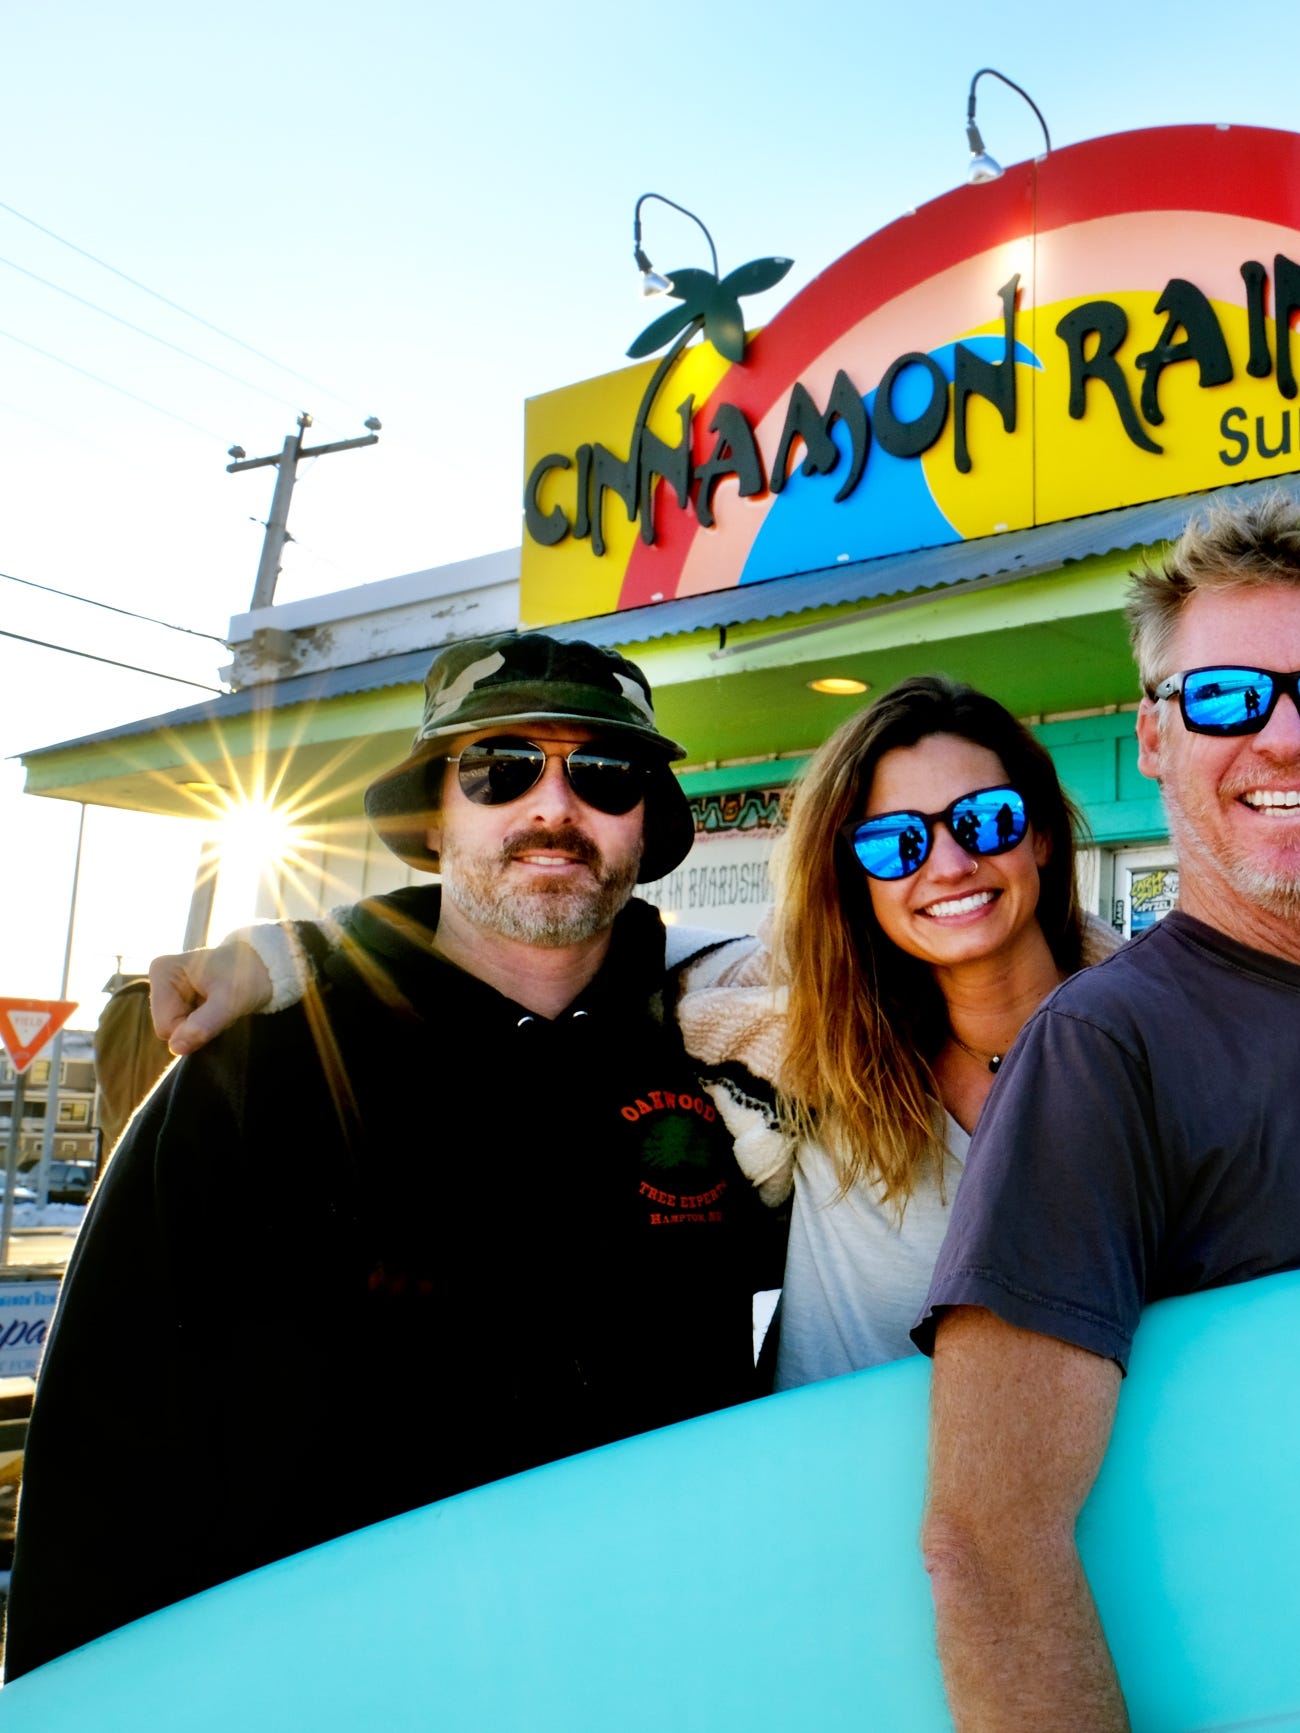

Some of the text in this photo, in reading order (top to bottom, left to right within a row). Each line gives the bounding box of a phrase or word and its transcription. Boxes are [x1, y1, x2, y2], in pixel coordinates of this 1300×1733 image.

[524, 273, 1022, 557] CINNAMON
[688, 860, 775, 908] BOARDSHO
[621, 1090, 715, 1122] OAKWOOD
[639, 1181, 676, 1206] TREE
